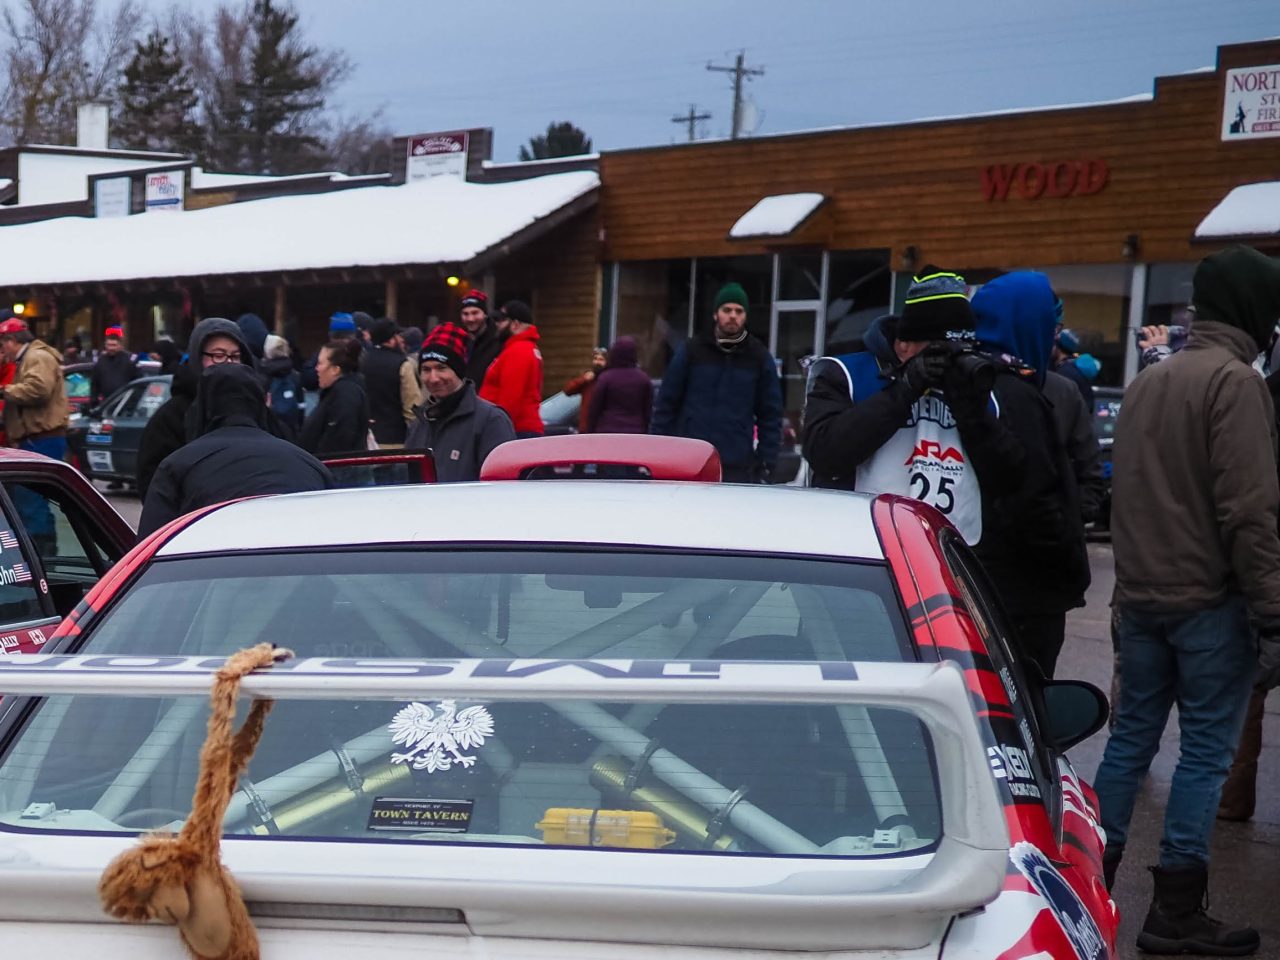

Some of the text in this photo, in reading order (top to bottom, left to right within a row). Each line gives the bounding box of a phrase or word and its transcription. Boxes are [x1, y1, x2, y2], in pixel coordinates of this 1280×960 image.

[1258, 107, 1280, 120] FIR
[980, 158, 1109, 203] WOOD
[910, 471, 956, 514] 25
[373, 809, 470, 821] TOWN TAVERN
